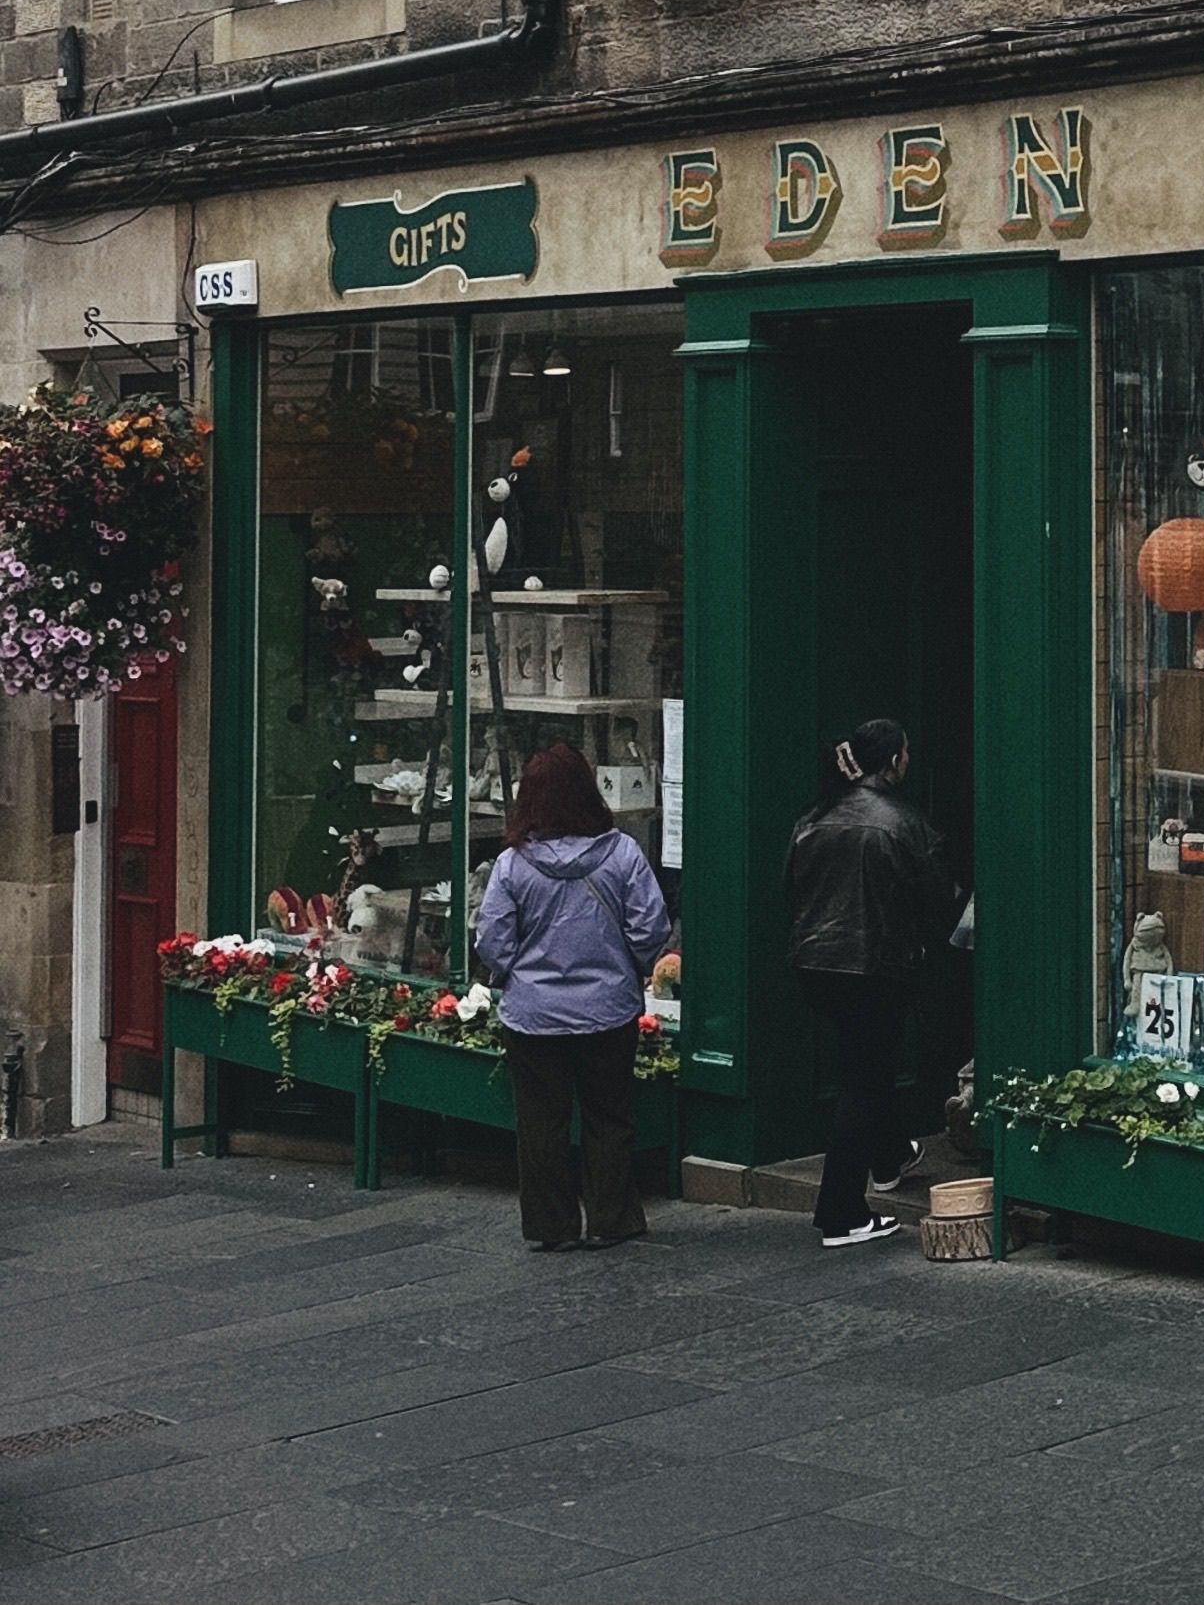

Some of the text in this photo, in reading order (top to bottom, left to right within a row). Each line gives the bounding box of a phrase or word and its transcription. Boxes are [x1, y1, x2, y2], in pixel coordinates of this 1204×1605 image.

[660, 105, 1090, 268] EDEN
[389, 211, 466, 267] GIFTS
[200, 271, 232, 301] CSS
[1145, 1002, 1175, 1040] 25
